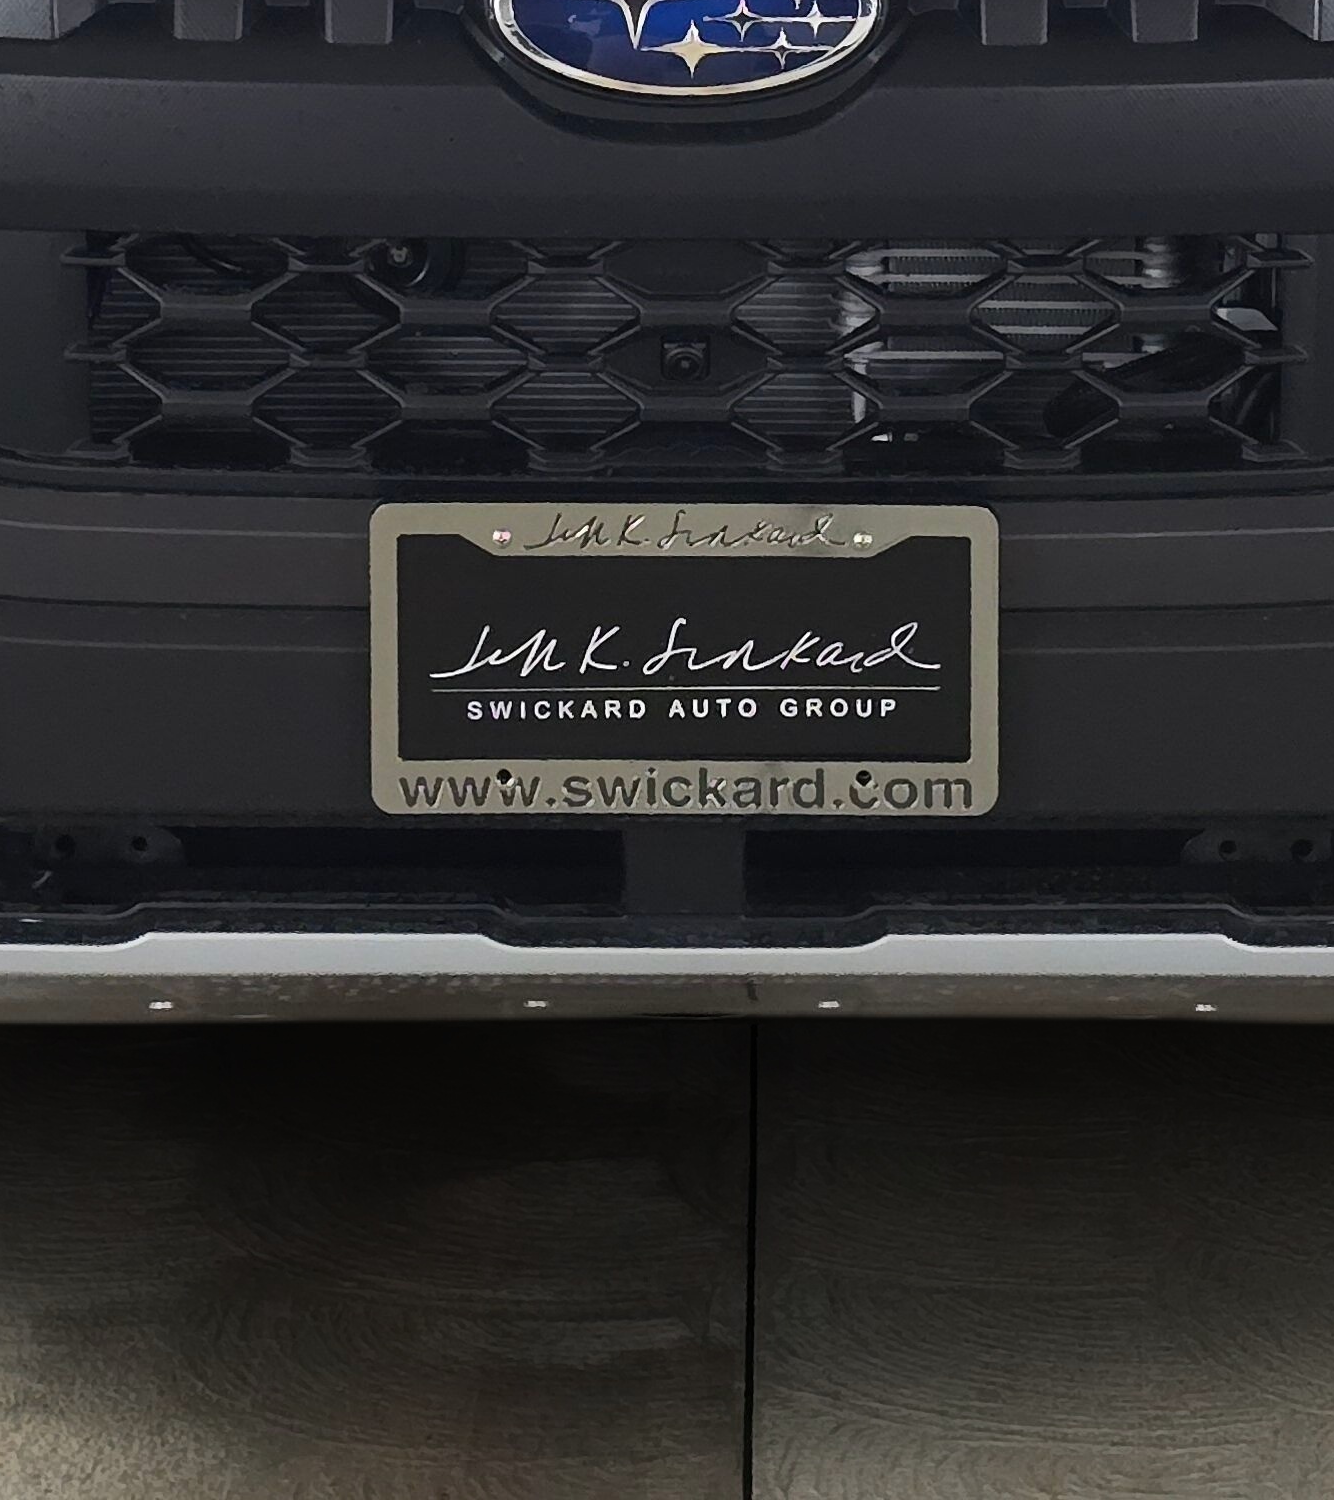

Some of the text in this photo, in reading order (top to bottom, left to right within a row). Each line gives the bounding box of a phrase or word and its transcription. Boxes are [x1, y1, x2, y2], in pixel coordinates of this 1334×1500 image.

[466, 698, 898, 722] SWICKARD AUTO GROUP
[398, 767, 974, 810] www.swickard.com
